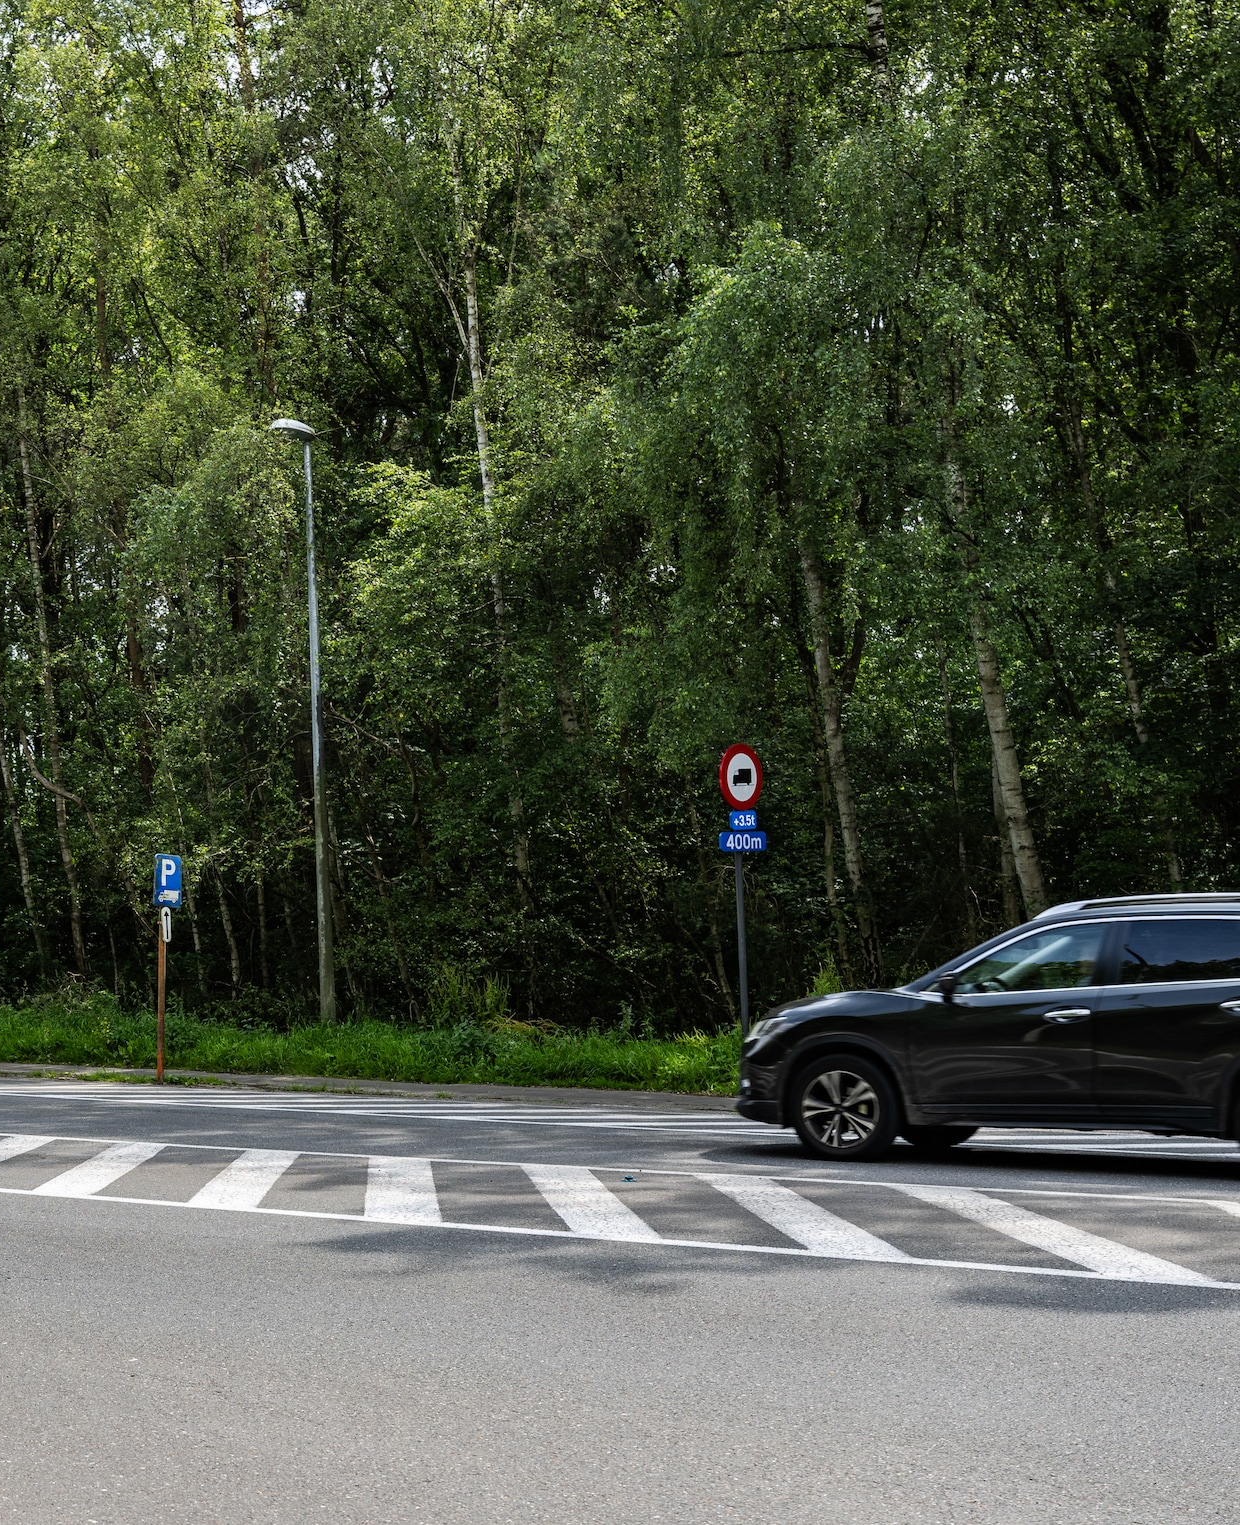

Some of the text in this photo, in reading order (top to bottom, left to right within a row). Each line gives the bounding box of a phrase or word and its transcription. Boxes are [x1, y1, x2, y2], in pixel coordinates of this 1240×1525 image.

[733, 814, 756, 827] +3.5t
[726, 833, 762, 850] 400m
[161, 858, 176, 887] P
